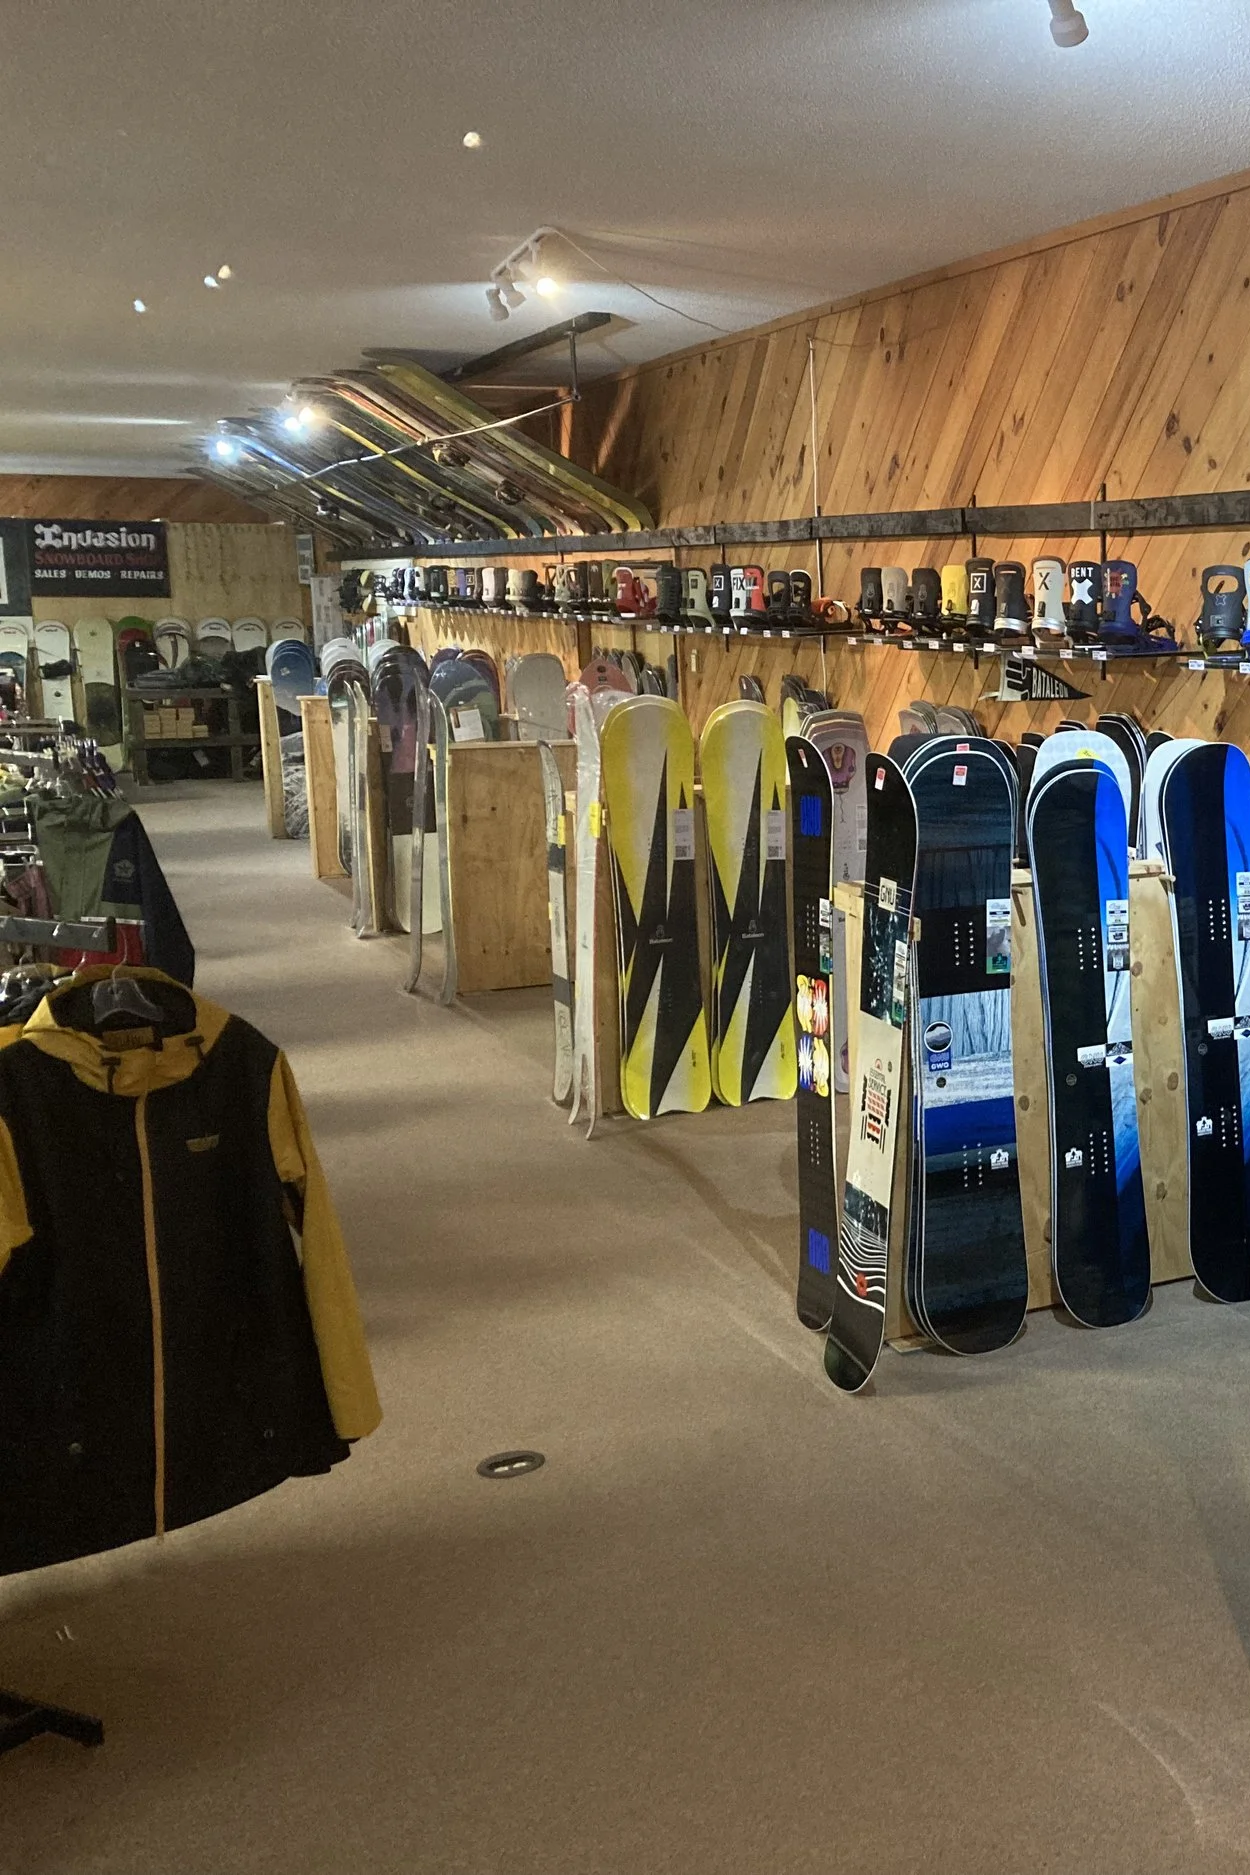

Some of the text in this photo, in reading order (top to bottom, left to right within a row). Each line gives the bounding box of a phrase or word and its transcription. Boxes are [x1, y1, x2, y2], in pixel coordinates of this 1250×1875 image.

[34, 523, 156, 551] Invasion
[35, 552, 123, 566] SNOWBOARD
[34, 569, 165, 580] SALES DEMOS REPAIRS
[1071, 567, 1094, 578] BENT
[1032, 666, 1069, 698] BATALEON
[880, 884, 896, 906] GNU
[931, 1061, 950, 1070] GWO
